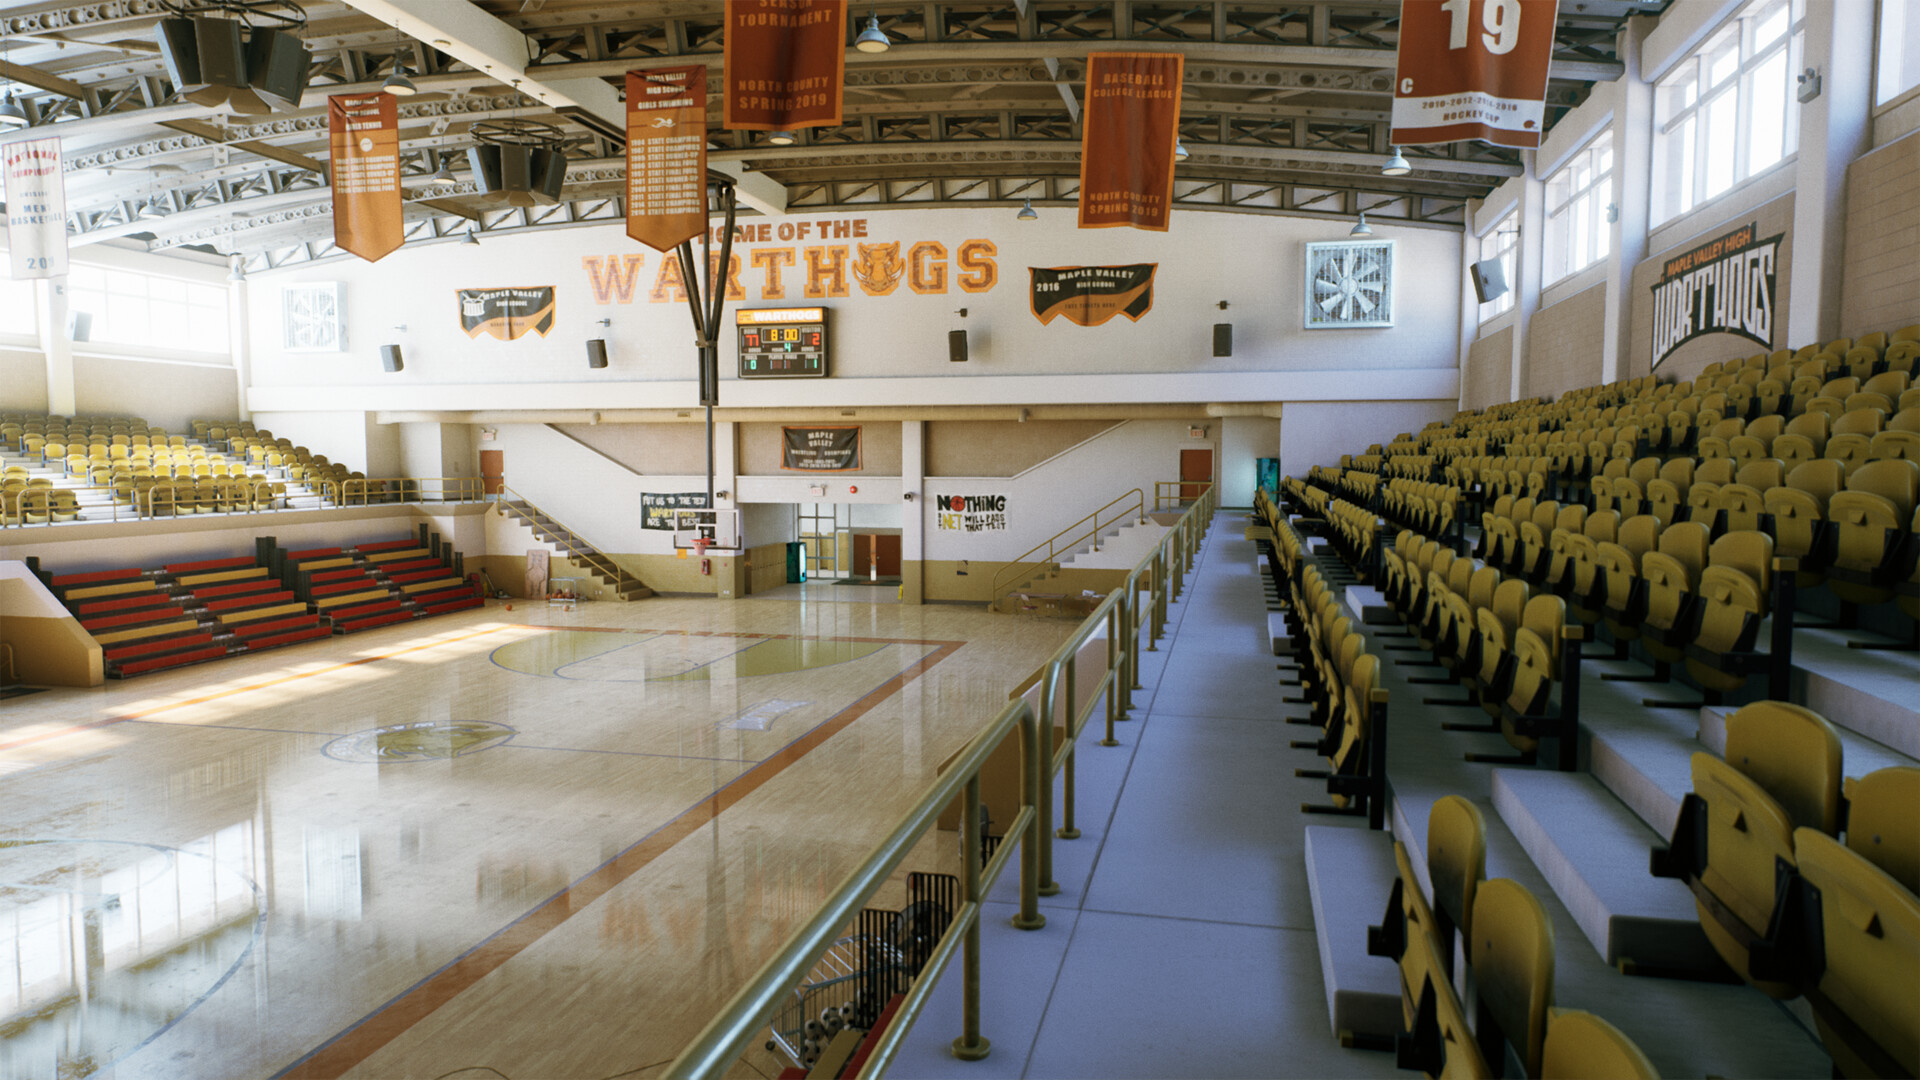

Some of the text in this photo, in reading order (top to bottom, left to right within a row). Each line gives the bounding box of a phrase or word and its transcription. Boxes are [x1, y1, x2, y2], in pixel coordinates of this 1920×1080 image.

[738, 9, 832, 28] TOURNAMENT
[1441, 0, 1521, 55] 19
[738, 76, 828, 92] NORTH COUNTY
[1104, 72, 1164, 86] BASEBALL
[1400, 77, 1414, 94] C
[1094, 88, 1172, 98] COLLEGE LEAGUE
[739, 93, 827, 111] SPRING 2019
[1443, 110, 1484, 121] HOCKEY
[1090, 191, 1160, 204] NORTH COUNTY
[1090, 202, 1158, 216] SPRING 2019
[778, 222, 810, 242] OF
[816, 218, 868, 240] THE
[1667, 228, 1752, 278] MAPLE VALLEY HIGH
[1058, 269, 1134, 280] MAPLE VALLEY
[1036, 282, 1060, 292] 2016
[483, 290, 543, 300] MAPLE VALLEY
[1652, 242, 1775, 368] WARTHOGS
[753, 310, 820, 322] WARTHOGS
[745, 334, 759, 346] 77
[770, 328, 798, 341] 8:00
[812, 333, 820, 345] 2
[784, 342, 791, 352] 4
[750, 360, 757, 370] 0
[808, 431, 833, 439] MAPLE
[808, 439, 833, 447] VALLEY
[643, 495, 655, 506] PUT
[666, 496, 675, 505] TO
[679, 496, 691, 505] THE
[647, 518, 661, 526] ARE
[943, 514, 962, 530] NET
[964, 514, 1004, 523] WILL PASS
[965, 523, 983, 532] THAT
